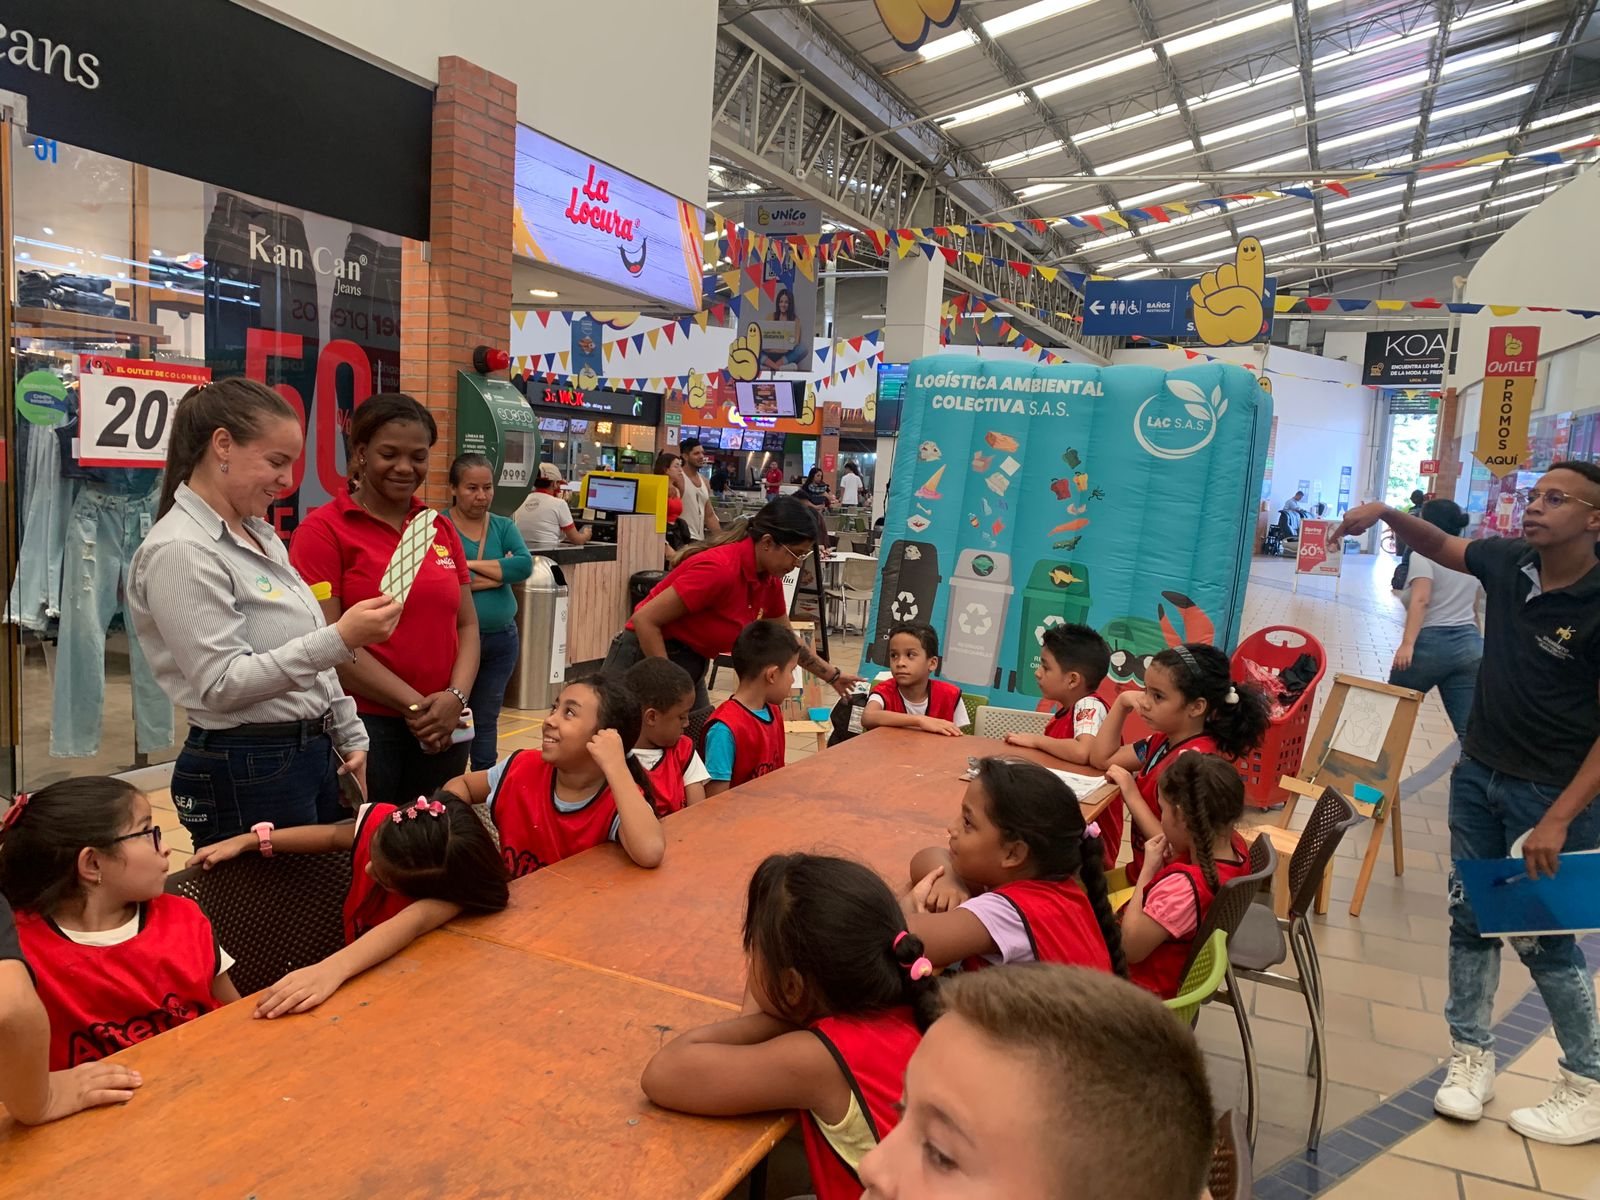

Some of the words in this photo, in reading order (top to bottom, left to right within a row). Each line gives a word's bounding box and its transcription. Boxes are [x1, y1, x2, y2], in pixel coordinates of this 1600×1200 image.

[34, 137, 57, 163] 01
[583, 164, 609, 203] La
[565, 187, 634, 241] Locura
[248, 223, 304, 270] Kan
[334, 278, 362, 297] Jeans
[1146, 300, 1171, 309] BAÑOS
[1385, 333, 1458, 357] KOA
[116, 366, 126, 374] EL
[126, 367, 154, 377] OUTLET
[1487, 361, 1535, 373] OUTLET
[915, 371, 997, 391] LOGÍSTICA
[1000, 376, 1104, 397] AMBIENTAL
[932, 395, 1025, 414] COLECTIVA
[1029, 401, 1070, 417] S.A.S.
[1498, 379, 1514, 450] PROMOS
[95, 386, 169, 450] 20
[1147, 416, 1172, 428] LAC
[1174, 417, 1207, 432] S.A.S.
[1484, 454, 1519, 466] AQUÍ
[175, 795, 193, 809] SEA
